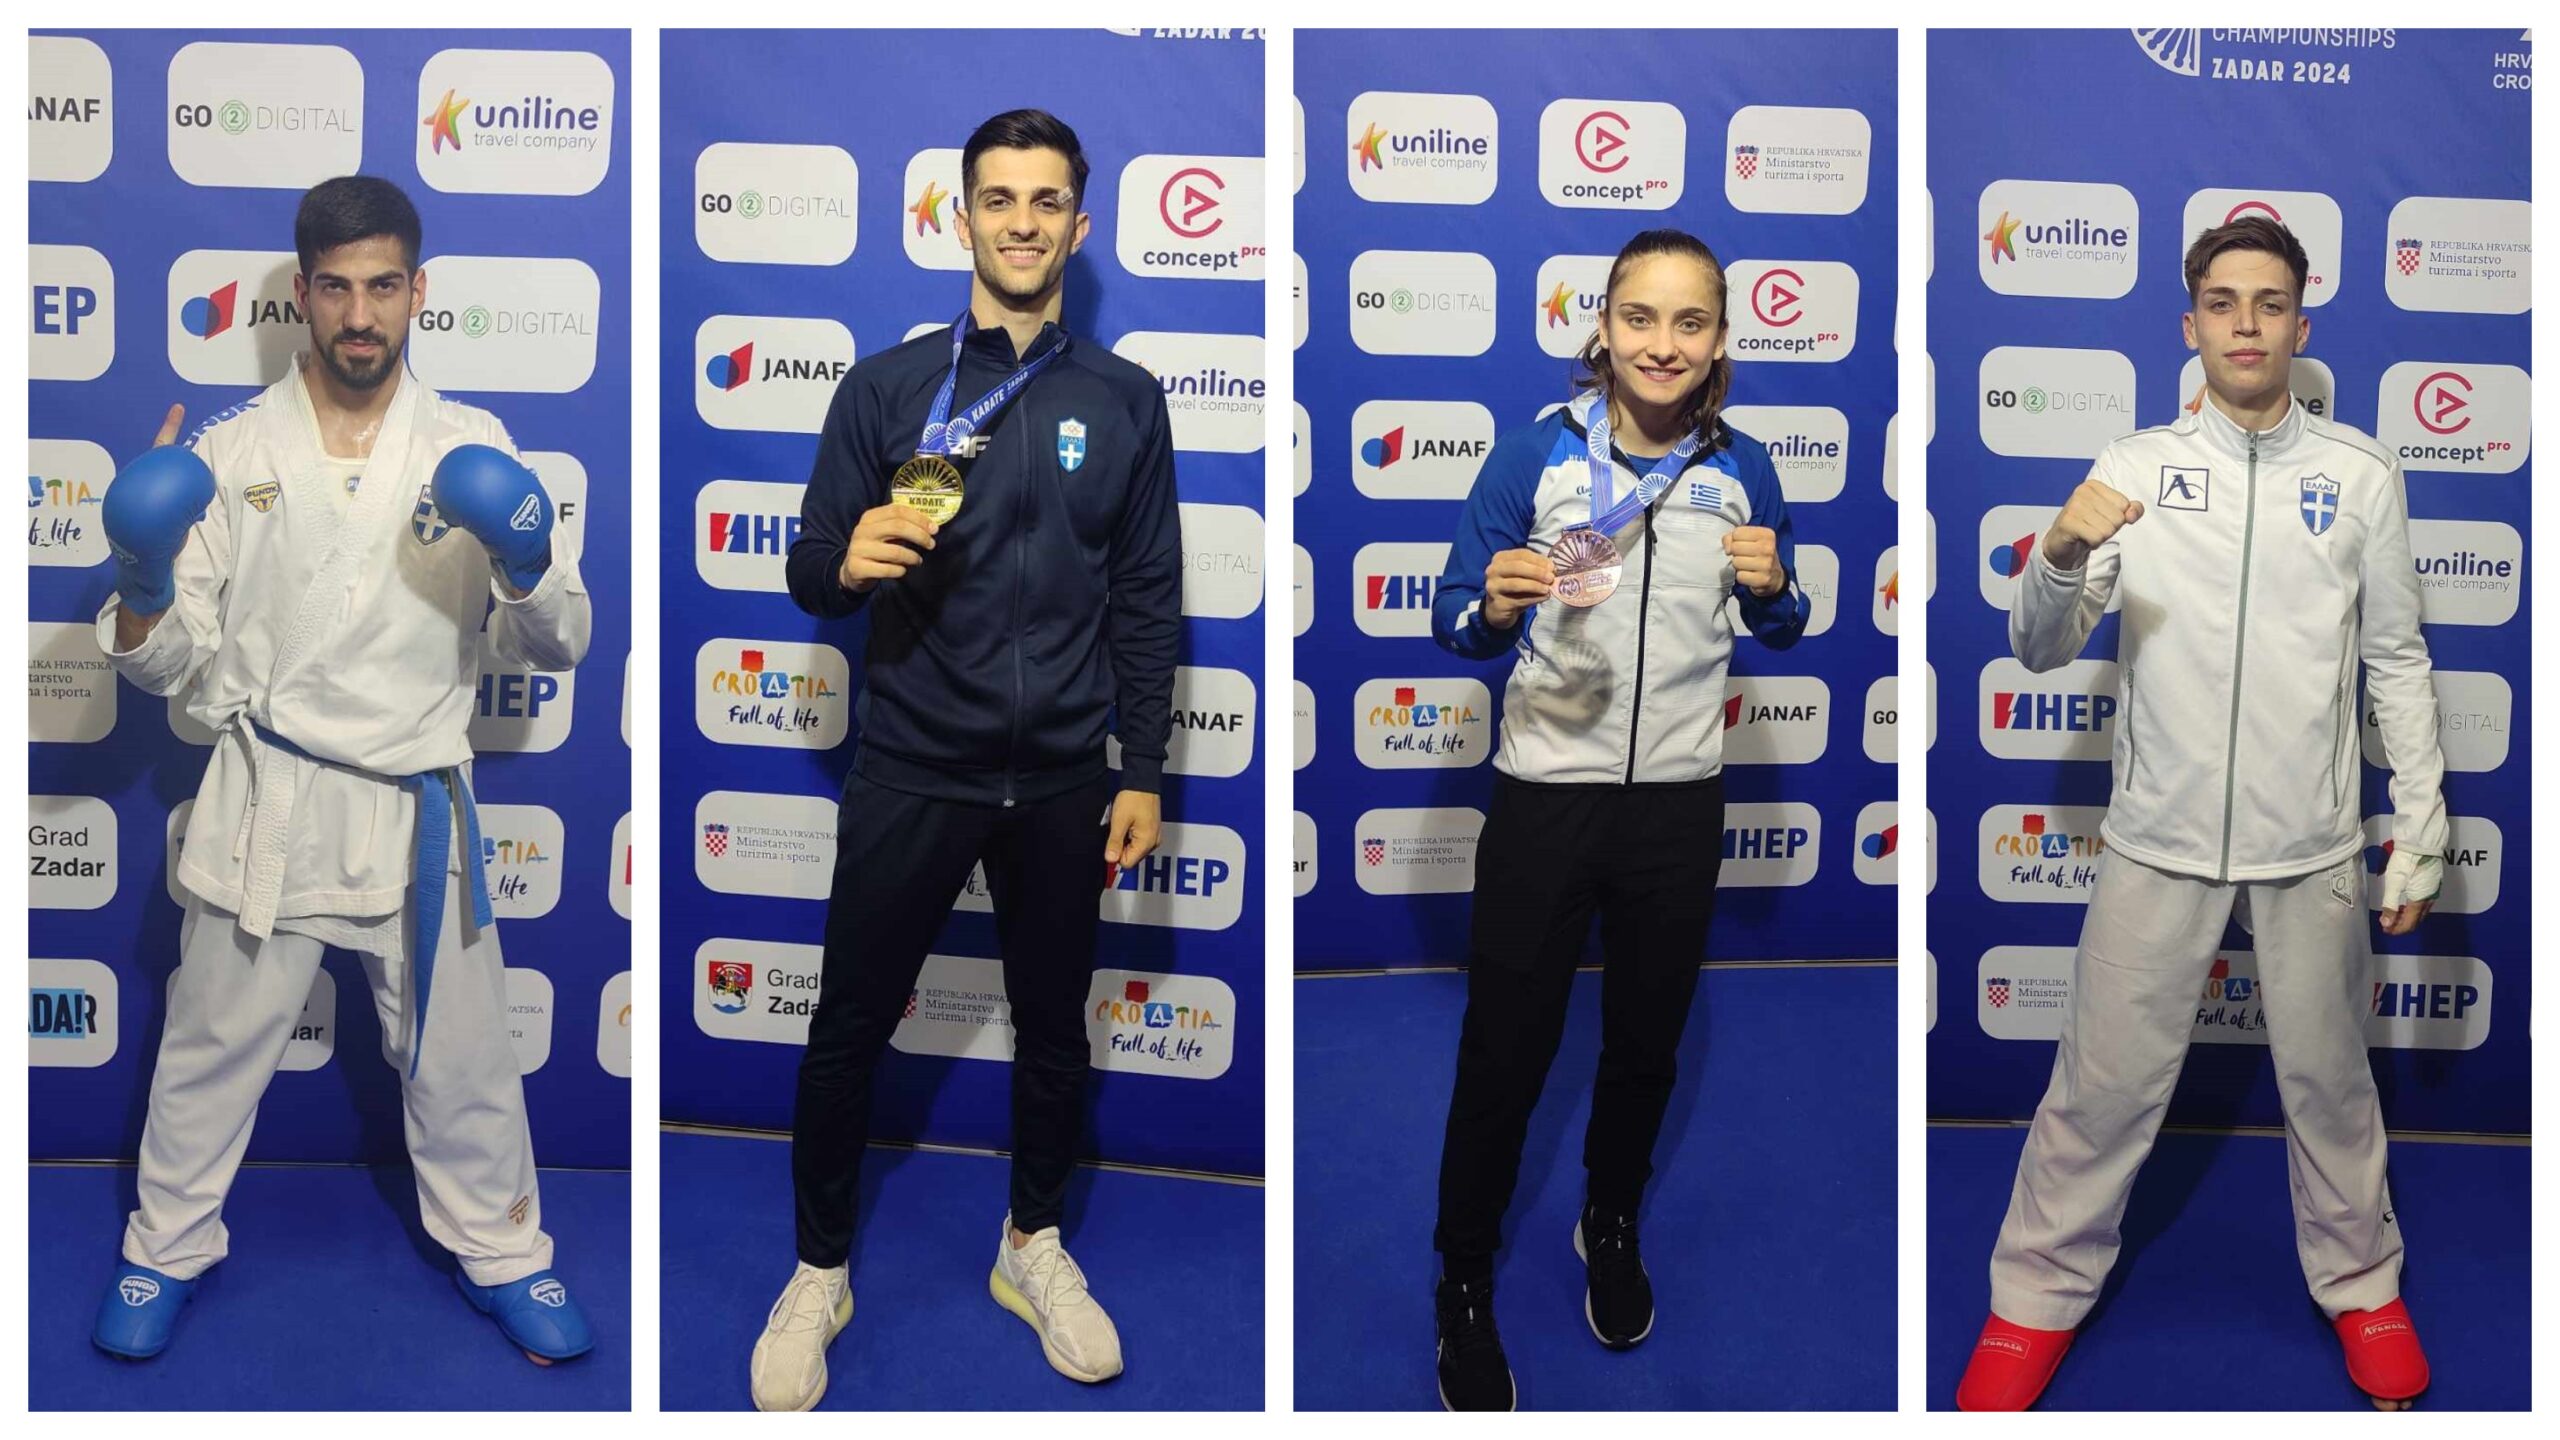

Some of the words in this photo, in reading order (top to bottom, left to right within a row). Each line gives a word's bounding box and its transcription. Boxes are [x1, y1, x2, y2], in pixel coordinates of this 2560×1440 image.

[2212, 28, 2396, 49] CHAMPIONSHIPS
[2212, 58, 2284, 82] ZADAR
[2293, 61, 2351, 84] 2024
[2494, 53, 2532, 69] HRV
[175, 105, 212, 128] GO
[256, 106, 354, 132] DIGITAL
[474, 96, 599, 130] uniline
[474, 133, 518, 147] travel
[524, 134, 597, 152] company
[1392, 129, 1487, 154] uniline
[1766, 146, 1814, 156] REPUBLIKA
[1816, 148, 1862, 157] HRVATSKA
[1392, 156, 1426, 167] travel
[1430, 157, 1487, 171] company
[1766, 158, 1830, 169] Ministarstvo
[1765, 170, 1803, 179] turizma
[1813, 172, 1844, 183] sporta
[1562, 181, 1643, 202] concept
[1646, 180, 1668, 192] pro
[702, 195, 732, 213] GO
[768, 196, 850, 218] DIGITAL
[2026, 218, 2127, 247] uniline
[2026, 248, 2062, 260] travel
[2067, 250, 2127, 264] company
[2430, 241, 2484, 251] REPUBLIKA
[2487, 243, 2532, 253] HRVATSK
[1143, 250, 1238, 269] concept
[2429, 253, 2501, 265] Ministarstvo
[2429, 266, 2472, 277] turizma
[2482, 268, 2516, 280] sporta
[1357, 292, 1385, 309] GO
[1418, 293, 1492, 312] DIGITAL
[248, 300, 312, 328] JAN
[419, 310, 454, 331] GO
[498, 312, 592, 335] DIGITAL
[1738, 334, 1815, 353] concept
[1817, 332, 1838, 345] pro
[762, 358, 847, 382] JANAF
[971, 390, 1006, 423] KARATE
[1201, 399, 1264, 416] company
[1987, 390, 2016, 408] GO
[2052, 392, 2130, 413] DIGITAL
[1411, 439, 1486, 457] JANAF
[2400, 443, 2484, 463] concept
[2487, 440, 2510, 454] pro
[1782, 460, 1838, 471] company
[2416, 552, 2511, 577] uniline
[2418, 578, 2449, 589] ravel
[2452, 579, 2510, 592] company
[54, 661, 112, 671] HRVATSKA
[51, 688, 91, 700] sporta
[713, 671, 838, 698] CROATIA
[794, 711, 820, 732] life
[1369, 705, 1480, 728] CROATIA
[1748, 706, 1817, 722] JANAF
[1873, 710, 1897, 725] GO
[2038, 694, 2116, 731] HEP
[1441, 735, 1465, 753] life
[29, 826, 88, 847] Grad
[736, 838, 805, 851] Ministarstvo
[1740, 828, 1808, 858] HEP
[736, 848, 777, 860] turizma
[787, 852, 821, 864] sporta
[1392, 846, 1453, 855] Ministarstvo
[1392, 855, 1428, 864] turizma
[1437, 854, 1466, 866] sporta
[31, 856, 105, 877] Zadar
[1146, 856, 1229, 897] HEP
[767, 969, 819, 990] Grad
[2018, 978, 2067, 987] REPUBLIKA
[926, 990, 977, 1000] REPUBLIKA
[2018, 999, 2055, 1008] turizma
[2402, 986, 2478, 1019] HEP
[28, 993, 96, 1034] DA!R
[925, 1000, 994, 1014] Ministarstvo
[1096, 1002, 1222, 1029] CROATIA
[925, 1011, 967, 1022] turizma
[978, 1015, 1009, 1027] sporta
[1177, 1039, 1202, 1059] life
